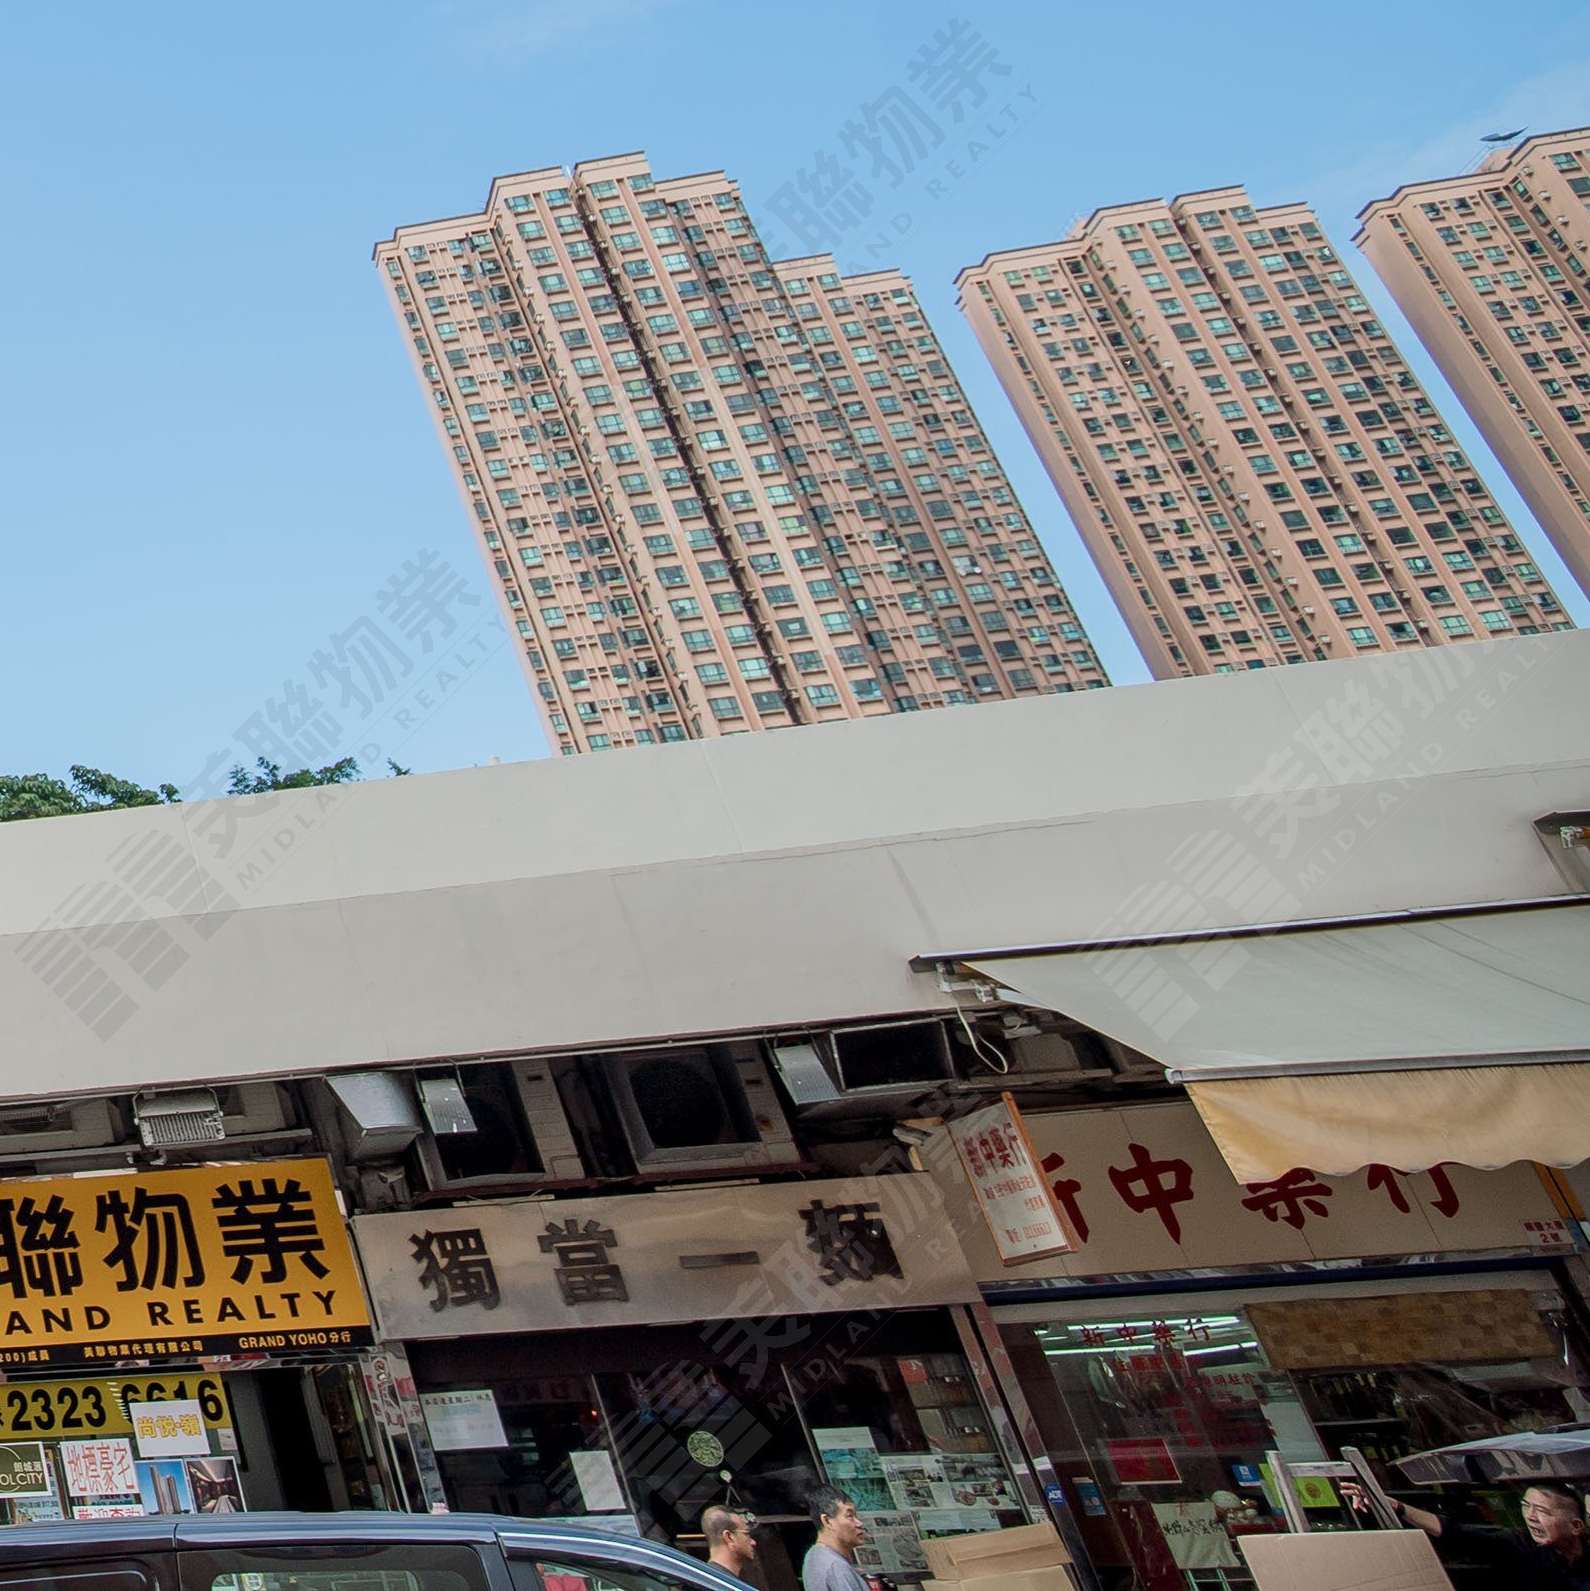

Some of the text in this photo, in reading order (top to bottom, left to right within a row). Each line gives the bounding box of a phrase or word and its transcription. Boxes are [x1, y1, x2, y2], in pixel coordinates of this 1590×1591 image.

[149, 1289, 340, 1327] REALTY
[239, 1330, 353, 1350] GRAND YOHO 分行
[6, 1381, 108, 1434] 2323
